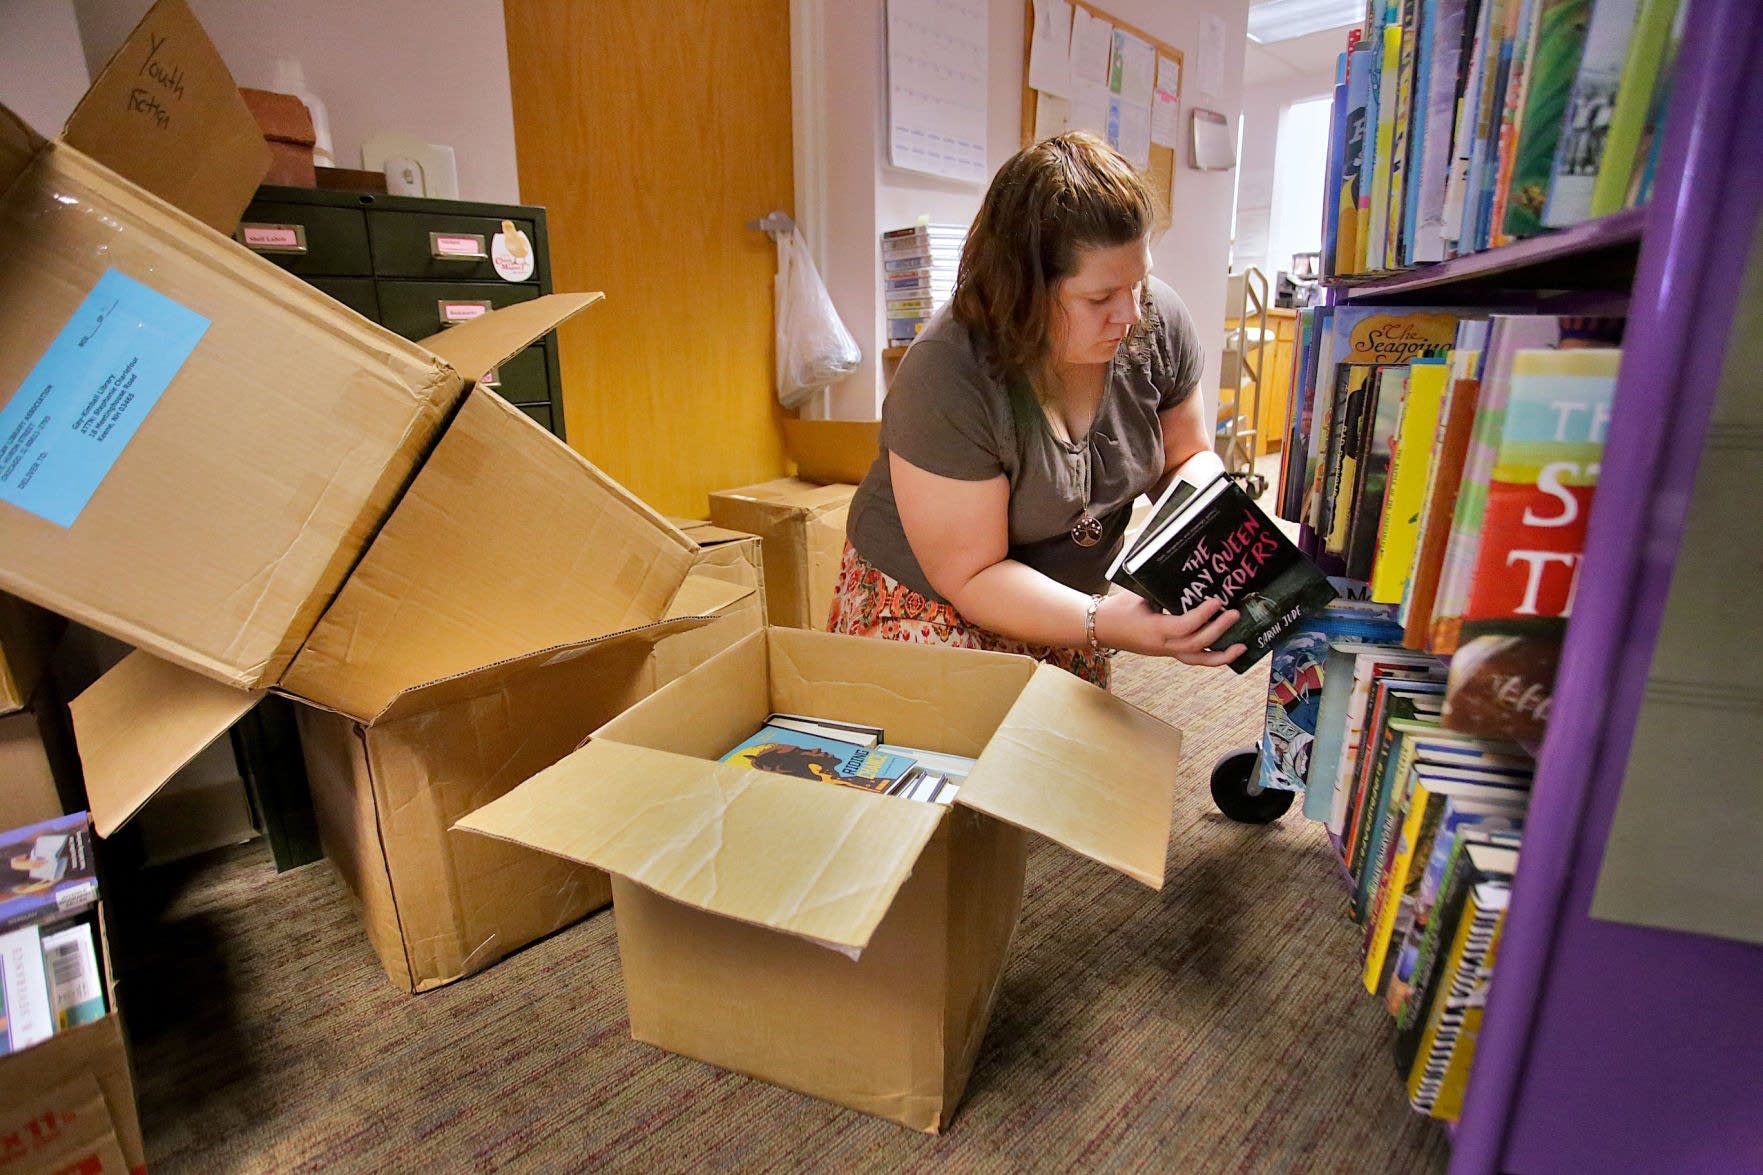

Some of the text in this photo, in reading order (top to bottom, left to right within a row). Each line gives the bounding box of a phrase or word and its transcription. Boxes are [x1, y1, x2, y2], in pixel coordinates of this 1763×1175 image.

[139, 32, 184, 101] Youth
[1383, 324, 1424, 341] The
[98, 374, 115, 394] Library
[94, 386, 116, 415] Stephanie
[95, 390, 126, 429] Meetinghouse
[122, 373, 137, 389] Road
[111, 410, 121, 421] NH
[17, 461, 40, 489] DELIVER
[1179, 567, 1215, 615] MAY
[1212, 509, 1262, 575] QUEEN
[1182, 535, 1211, 573] THE
[1257, 604, 1302, 649] SARAH JUDE
[842, 750, 869, 775] RIDING
